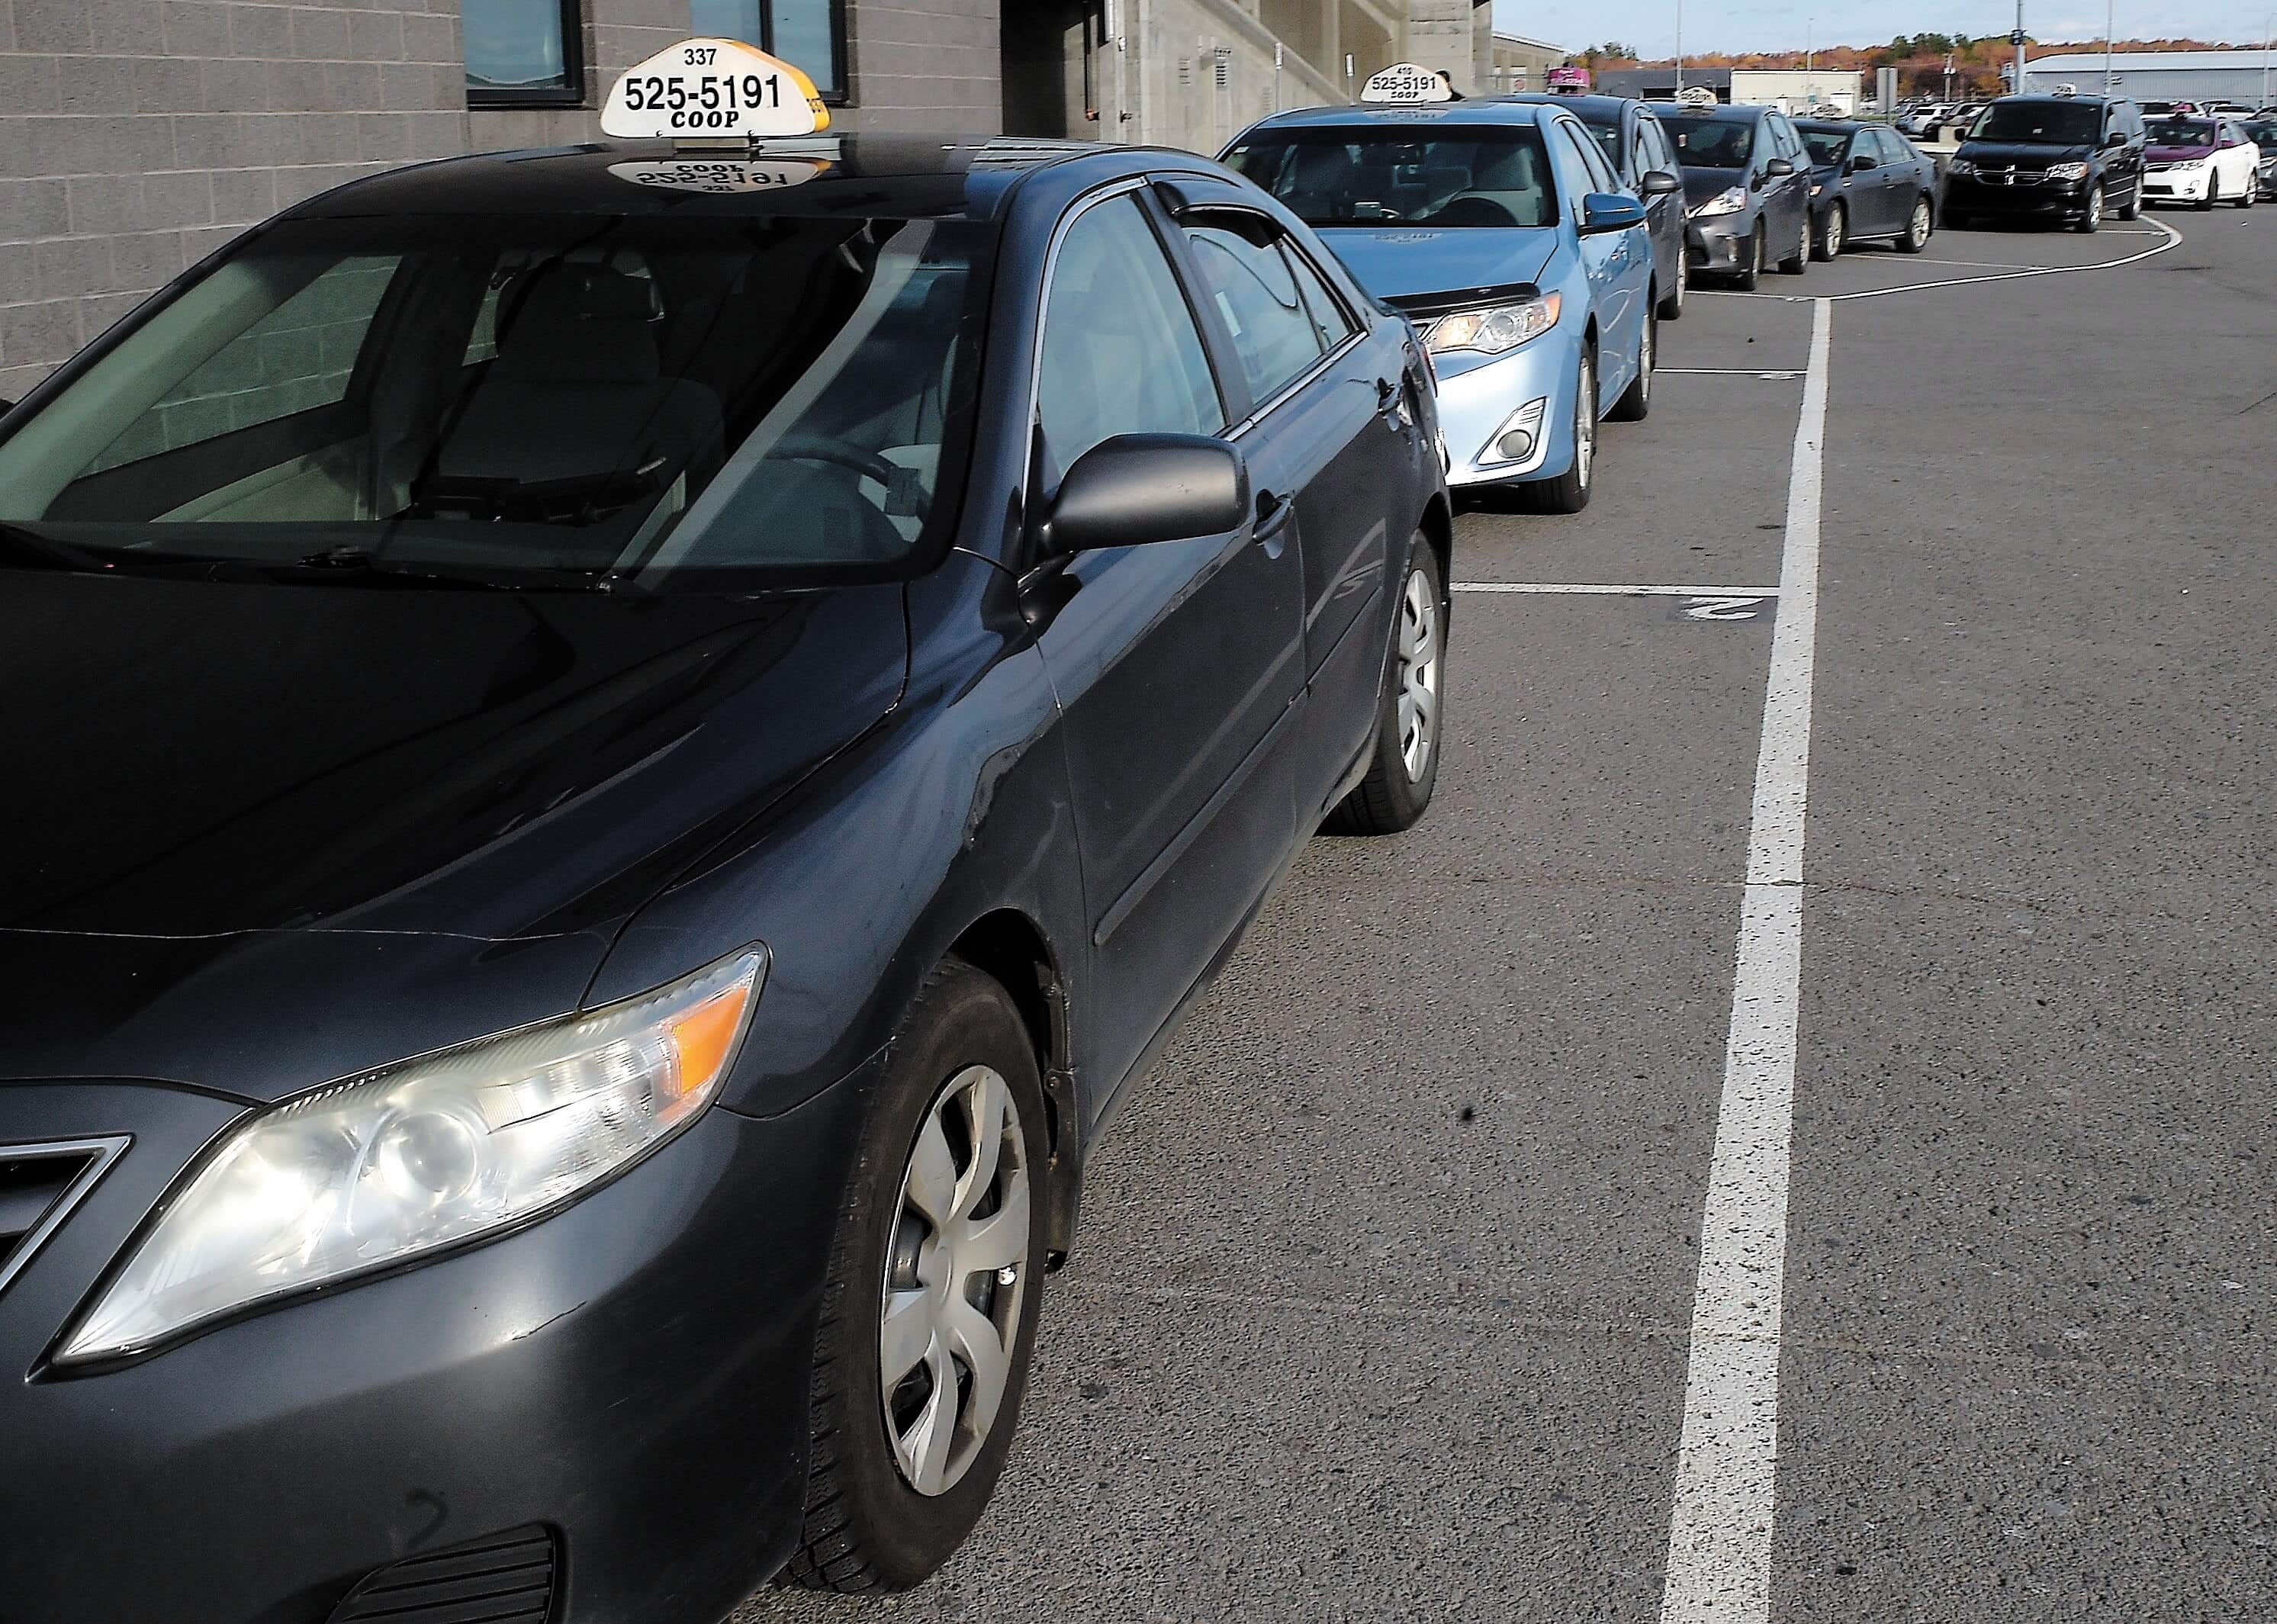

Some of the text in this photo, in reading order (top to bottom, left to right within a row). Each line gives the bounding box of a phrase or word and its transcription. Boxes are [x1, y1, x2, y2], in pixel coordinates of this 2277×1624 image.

[684, 48, 717, 66] 337
[1372, 77, 1436, 90] 525-5191
[626, 75, 779, 110] 525-5191
[671, 111, 739, 128] COOP
